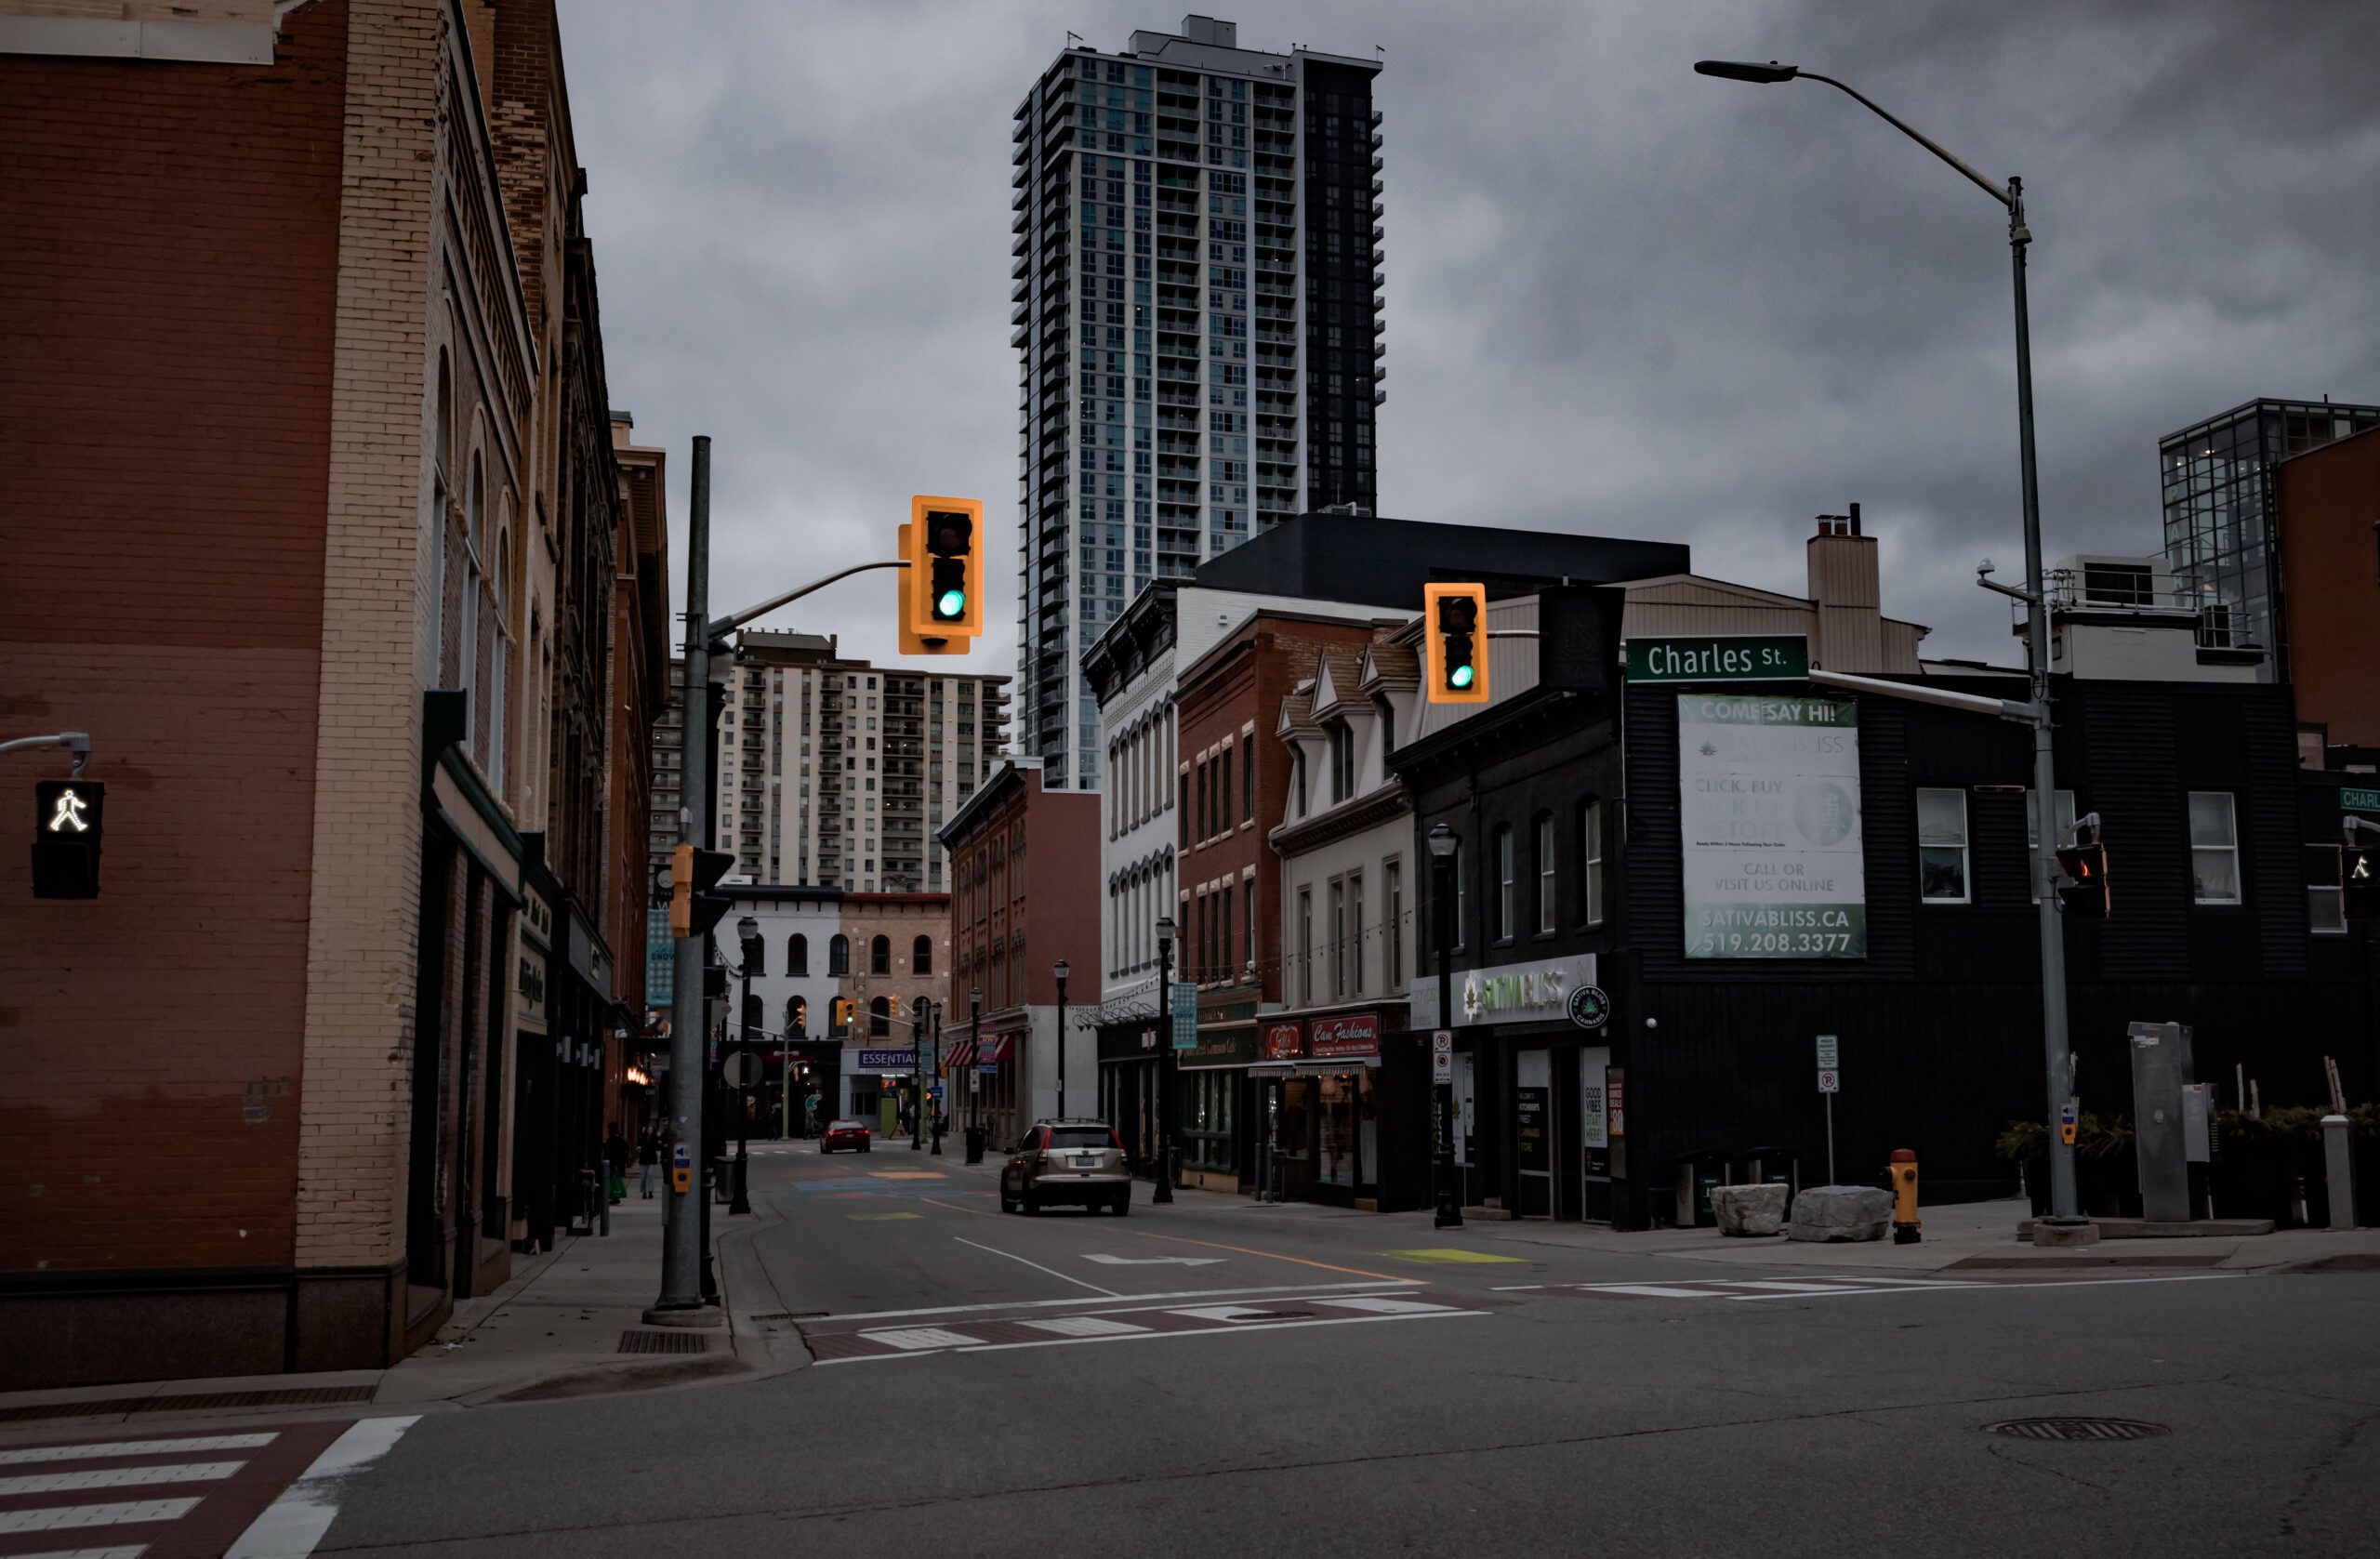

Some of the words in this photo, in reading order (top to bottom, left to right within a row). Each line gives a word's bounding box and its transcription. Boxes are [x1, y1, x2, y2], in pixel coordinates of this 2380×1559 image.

[1648, 643, 1752, 675] Charles
[1762, 648, 1787, 665] St.
[1701, 701, 1761, 720] COME
[1766, 704, 1802, 721] SAY
[1808, 705, 1836, 722] HI!
[1744, 863, 1778, 876] CALL
[1783, 863, 1805, 876] OR
[1715, 879, 1749, 891] VISIT
[1755, 879, 1773, 891] US
[1778, 879, 1834, 892] ONLINE
[1702, 910, 1849, 928] SATIVABLISS.CA
[1703, 933, 1851, 953] 519.208.3377
[1482, 971, 1564, 1011] SATIVABLISS
[1573, 989, 1590, 1006] SATIVA
[1576, 1012, 1606, 1025] CANNABIS
[1314, 1024, 1333, 1042] Cam
[1334, 1021, 1372, 1043] Fashions
[1586, 1087, 1601, 1099] GOOD
[1586, 1100, 1601, 1113] VIBES
